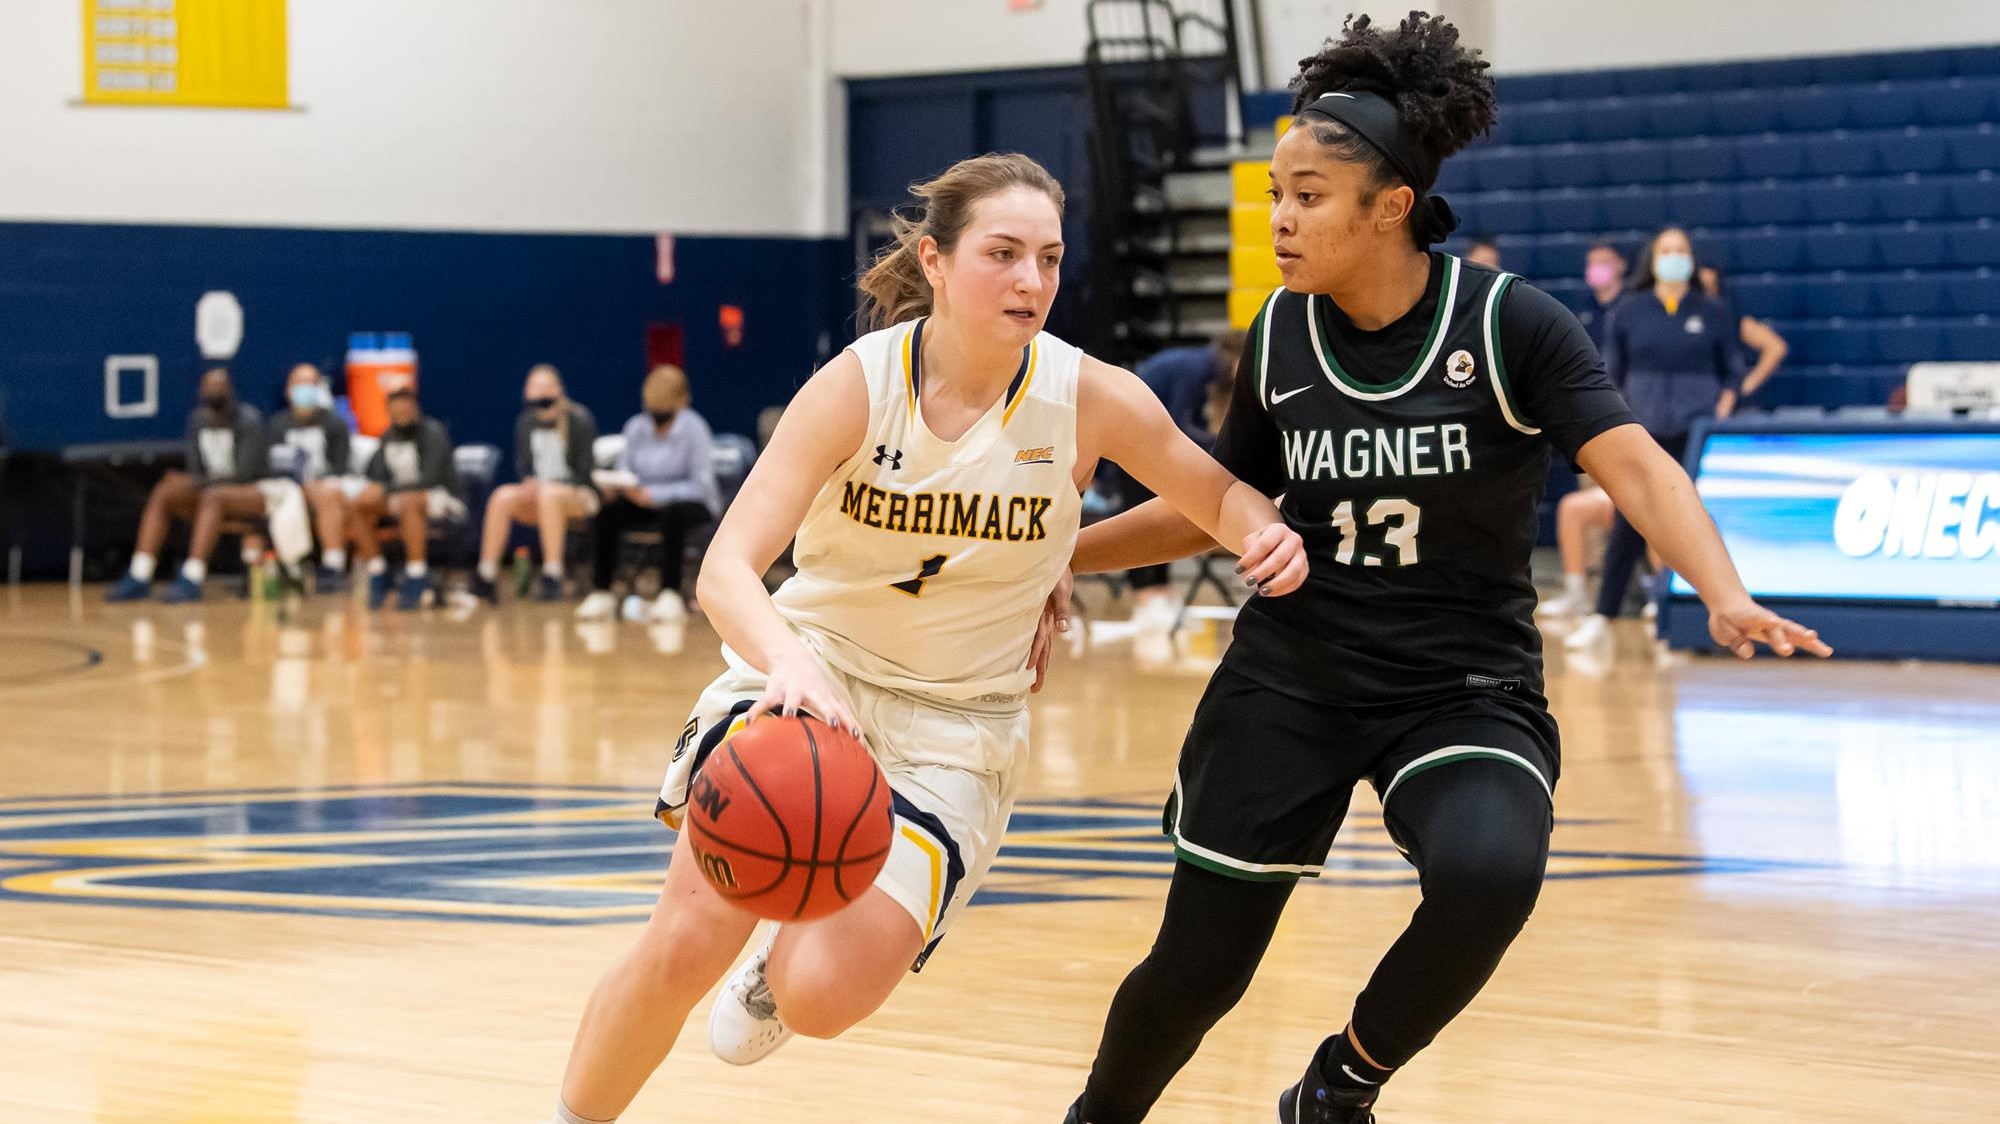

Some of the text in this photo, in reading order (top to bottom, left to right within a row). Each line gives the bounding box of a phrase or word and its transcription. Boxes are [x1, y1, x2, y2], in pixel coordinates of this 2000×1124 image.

[1443, 376, 1459, 388] United
[1013, 446, 1054, 463] NEC
[1282, 423, 1472, 481] WAGNER
[839, 480, 1052, 542] MERRIMACK
[1331, 498, 1421, 567] 13
[887, 552, 950, 598] 1
